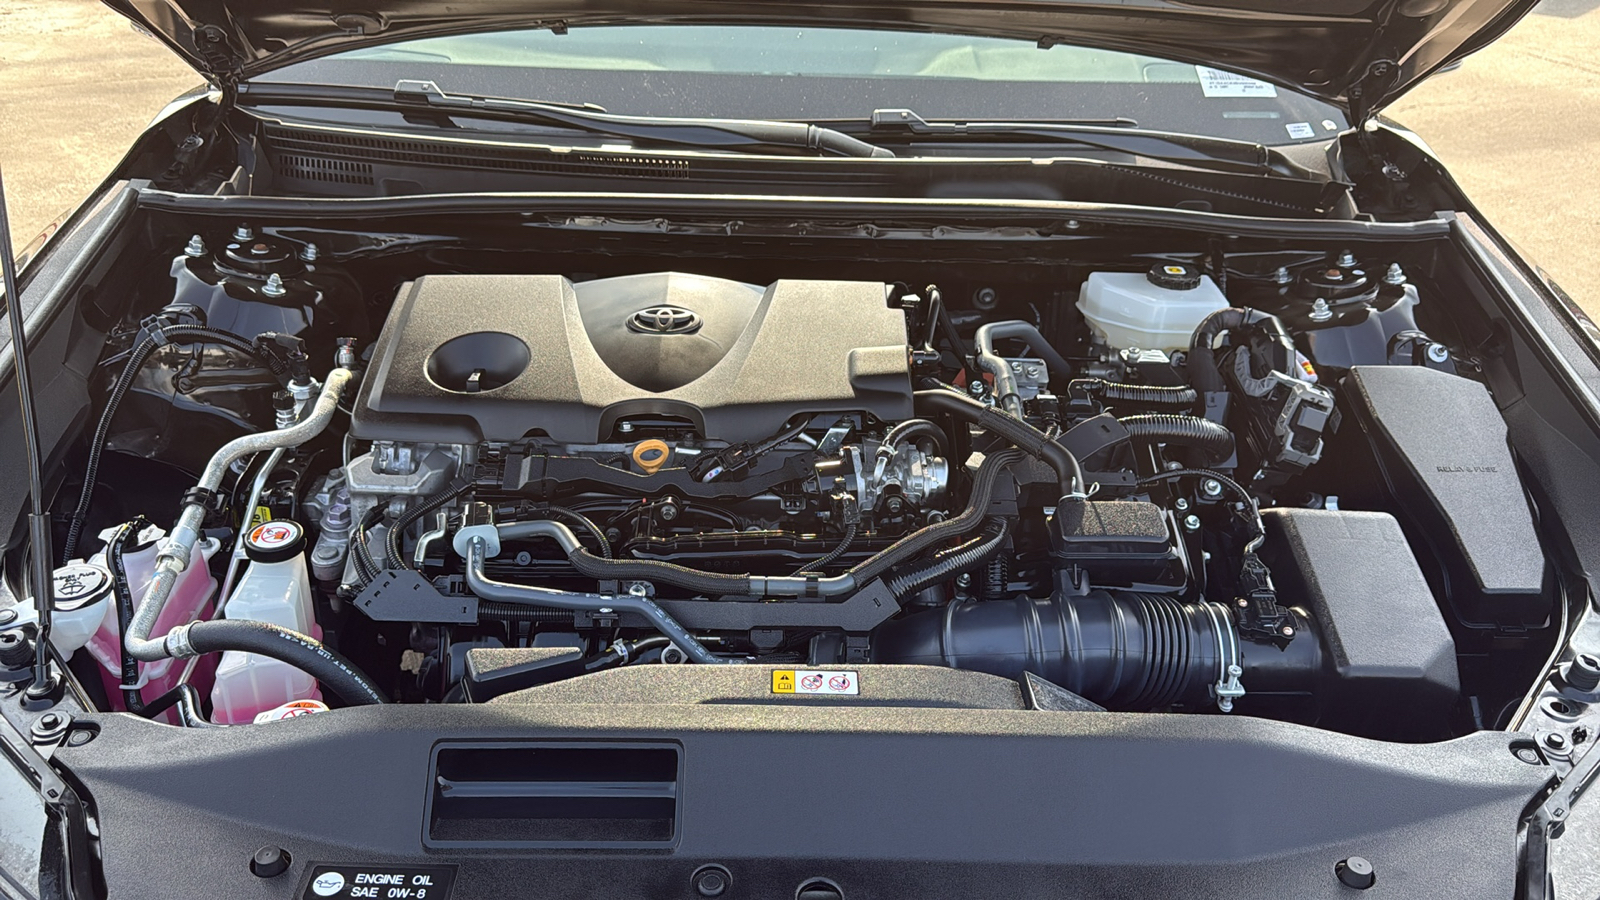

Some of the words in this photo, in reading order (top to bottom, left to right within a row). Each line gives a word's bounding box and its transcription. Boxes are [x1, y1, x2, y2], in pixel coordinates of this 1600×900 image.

[354, 873, 405, 885] ENGINE
[412, 874, 434, 886] OIL
[350, 886, 380, 898] SAE
[387, 887, 427, 899] 0W-8
